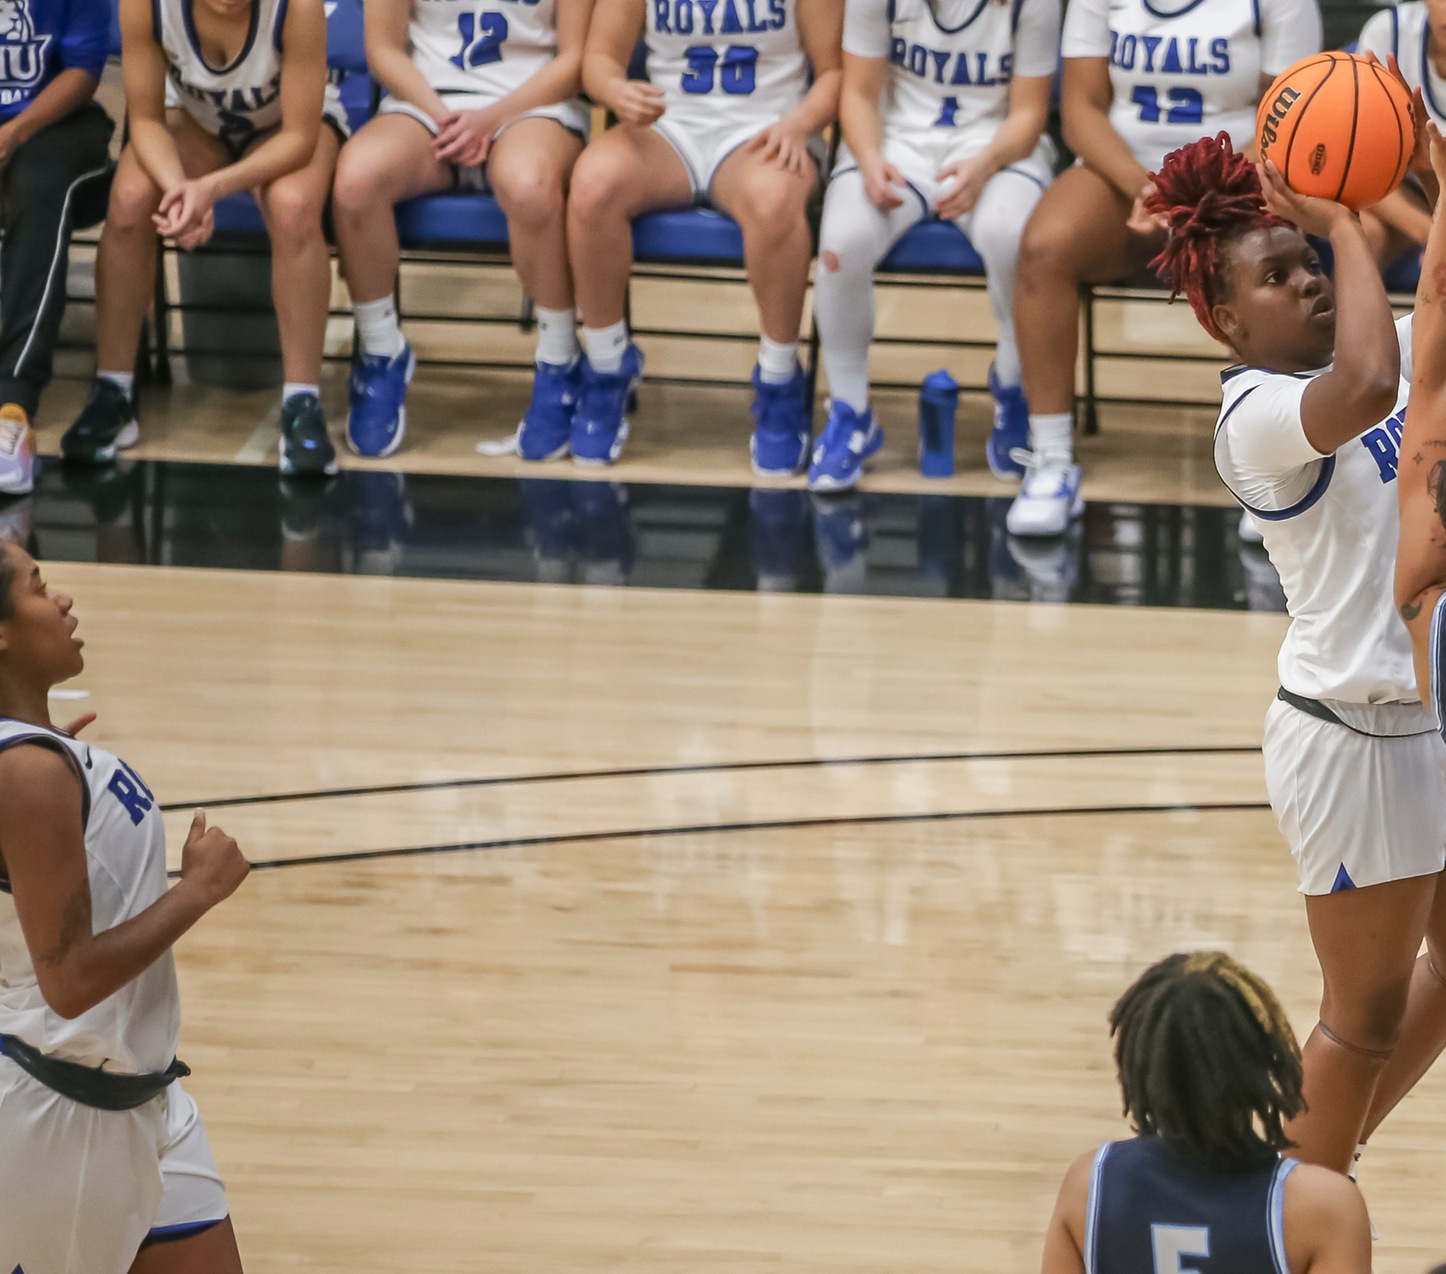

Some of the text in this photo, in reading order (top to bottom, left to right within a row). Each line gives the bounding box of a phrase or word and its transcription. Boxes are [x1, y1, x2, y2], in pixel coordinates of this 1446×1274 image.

[449, 11, 503, 71] 12
[656, 0, 787, 35] ROYALS
[889, 37, 1015, 87] ROYALS
[1260, 86, 1302, 165] Wilso
